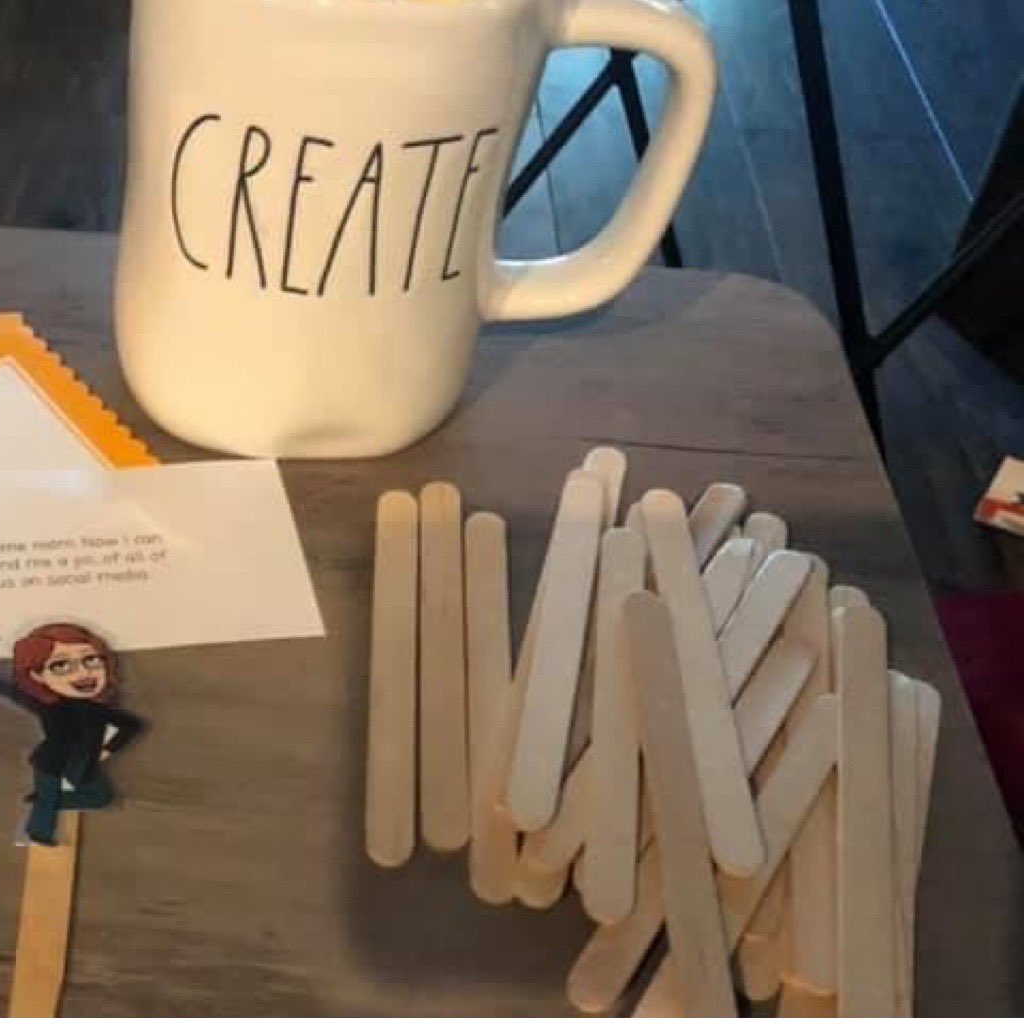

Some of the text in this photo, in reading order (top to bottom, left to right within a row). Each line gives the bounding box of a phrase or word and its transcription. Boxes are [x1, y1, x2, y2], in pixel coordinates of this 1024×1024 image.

[171, 113, 500, 297] CREATE
[25, 556, 52, 569] me
[57, 556, 69, 568] a
[21, 575, 43, 587] on
[47, 570, 93, 585] social
